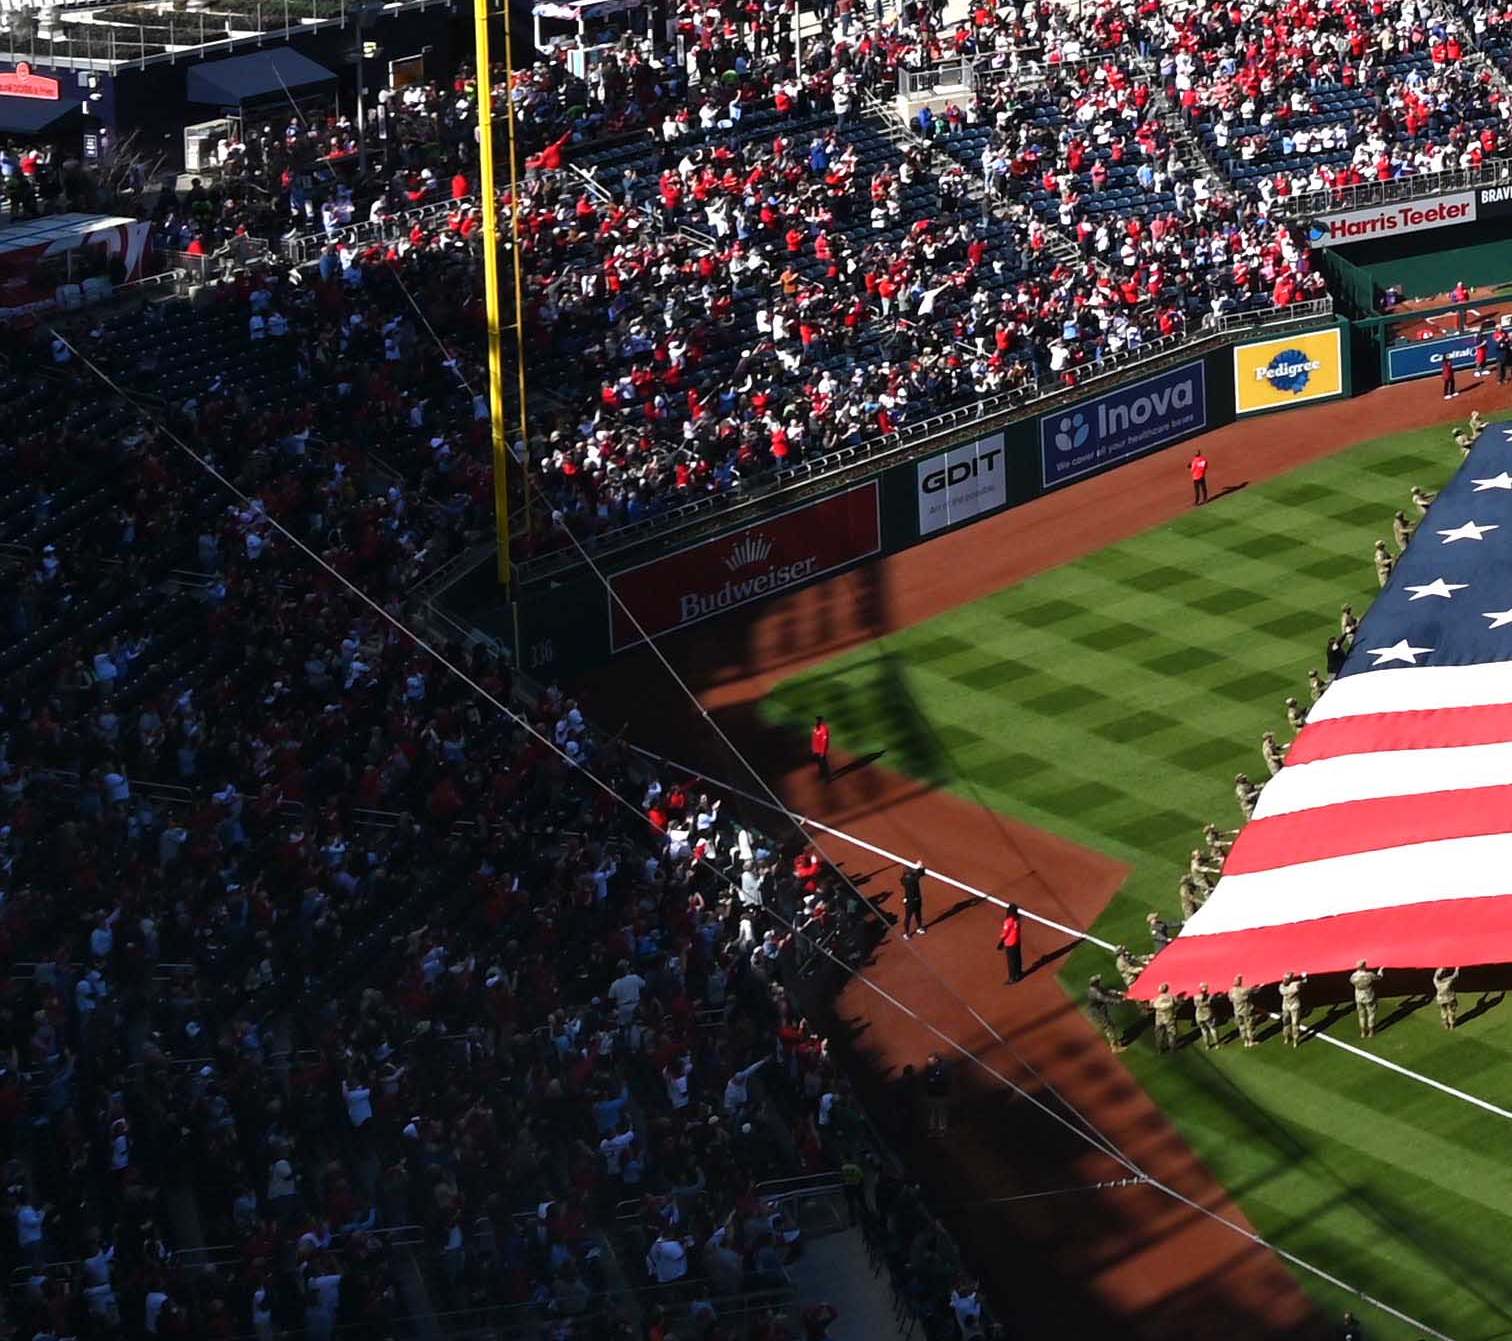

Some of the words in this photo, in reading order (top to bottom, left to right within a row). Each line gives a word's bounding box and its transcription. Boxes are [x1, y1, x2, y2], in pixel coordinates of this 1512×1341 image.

[1329, 212, 1398, 240] Harris
[1399, 201, 1471, 228] Teeter
[1255, 359, 1321, 382] Pedigree
[1098, 379, 1193, 439] Inova
[922, 448, 1001, 495] GDIT
[680, 555, 818, 623] Budweiser
